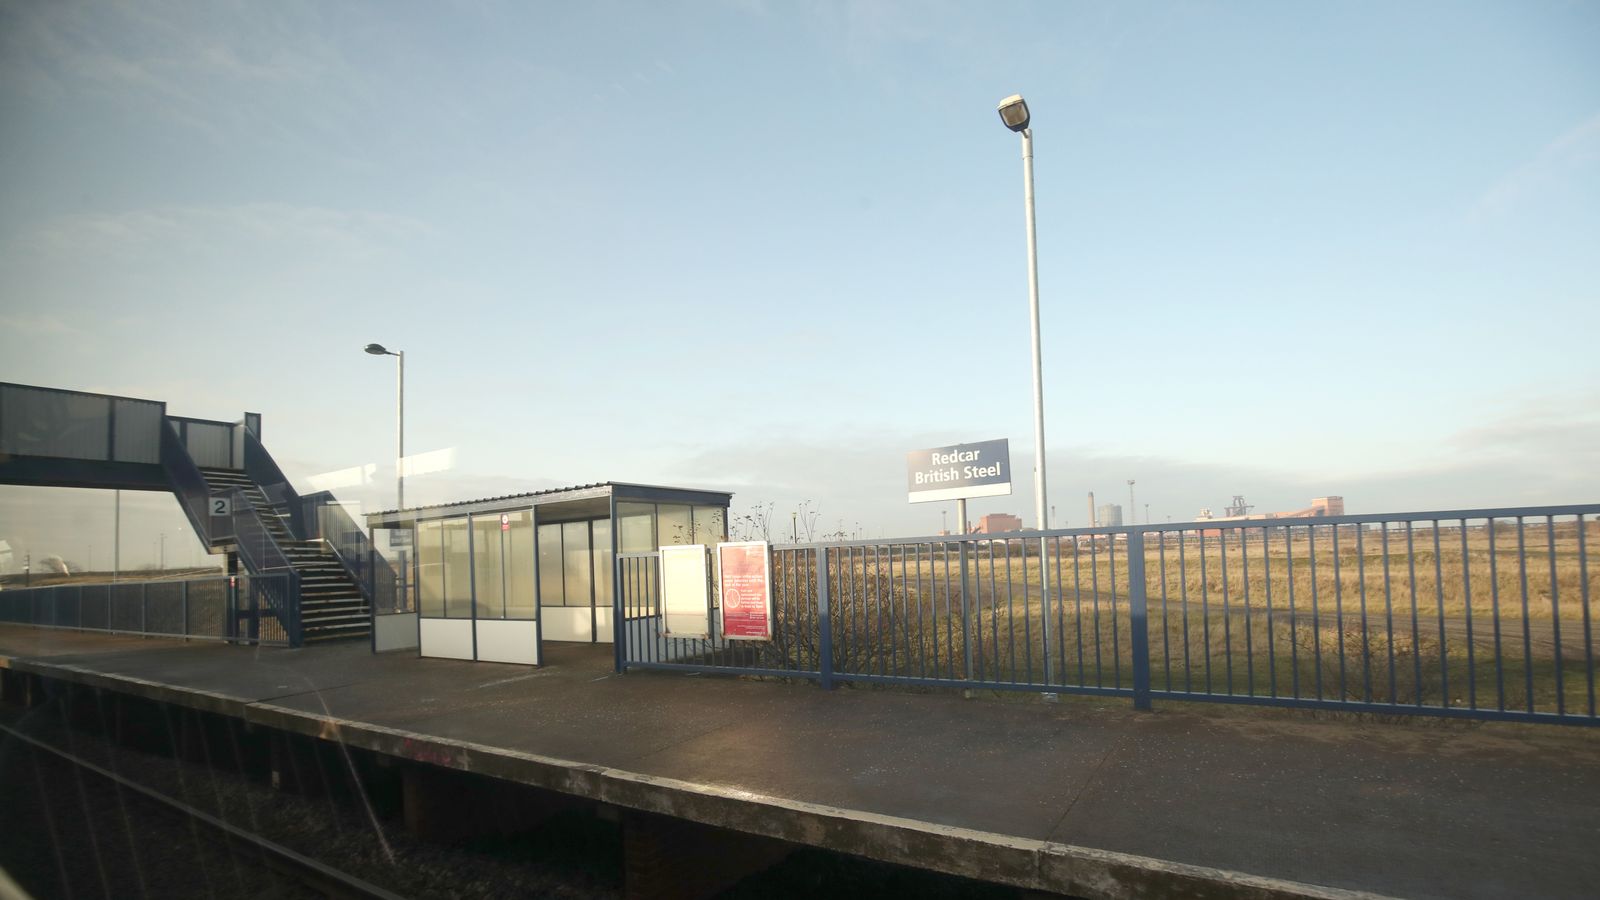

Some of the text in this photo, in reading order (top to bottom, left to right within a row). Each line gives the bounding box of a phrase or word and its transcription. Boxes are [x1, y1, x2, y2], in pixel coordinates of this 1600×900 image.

[932, 449, 980, 466] Redcar
[915, 462, 1001, 485] British Steel
[214, 500, 226, 514] 2
